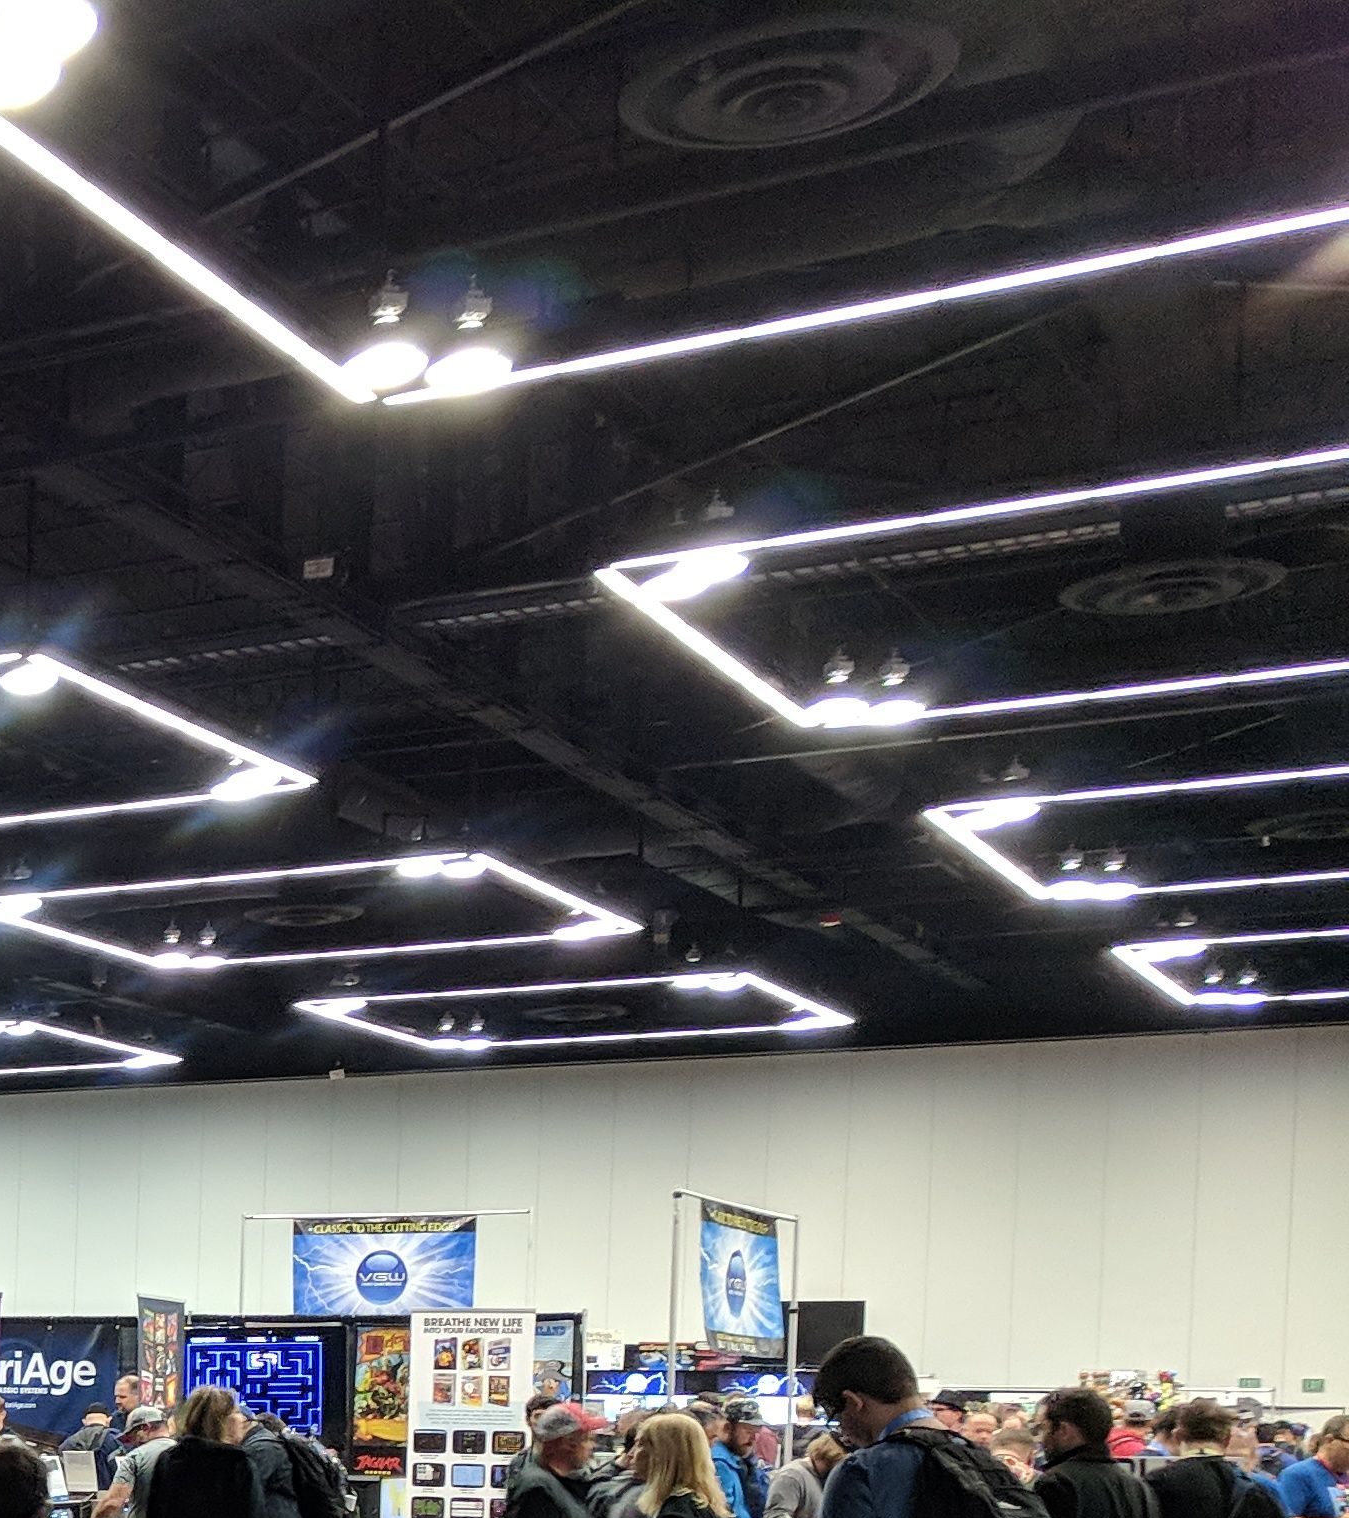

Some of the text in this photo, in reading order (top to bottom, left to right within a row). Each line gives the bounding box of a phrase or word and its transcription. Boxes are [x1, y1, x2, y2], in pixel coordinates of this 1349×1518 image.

[314, 1224, 351, 1234] CLASSIC
[366, 1223, 384, 1232] THE
[385, 1223, 427, 1232] CUTTING
[359, 1272, 405, 1282] VGW
[423, 1317, 523, 1327] BREATHE NEW LIFE
[0, 1350, 97, 1396] riAge
[354, 1454, 403, 1472] JAGUAR
